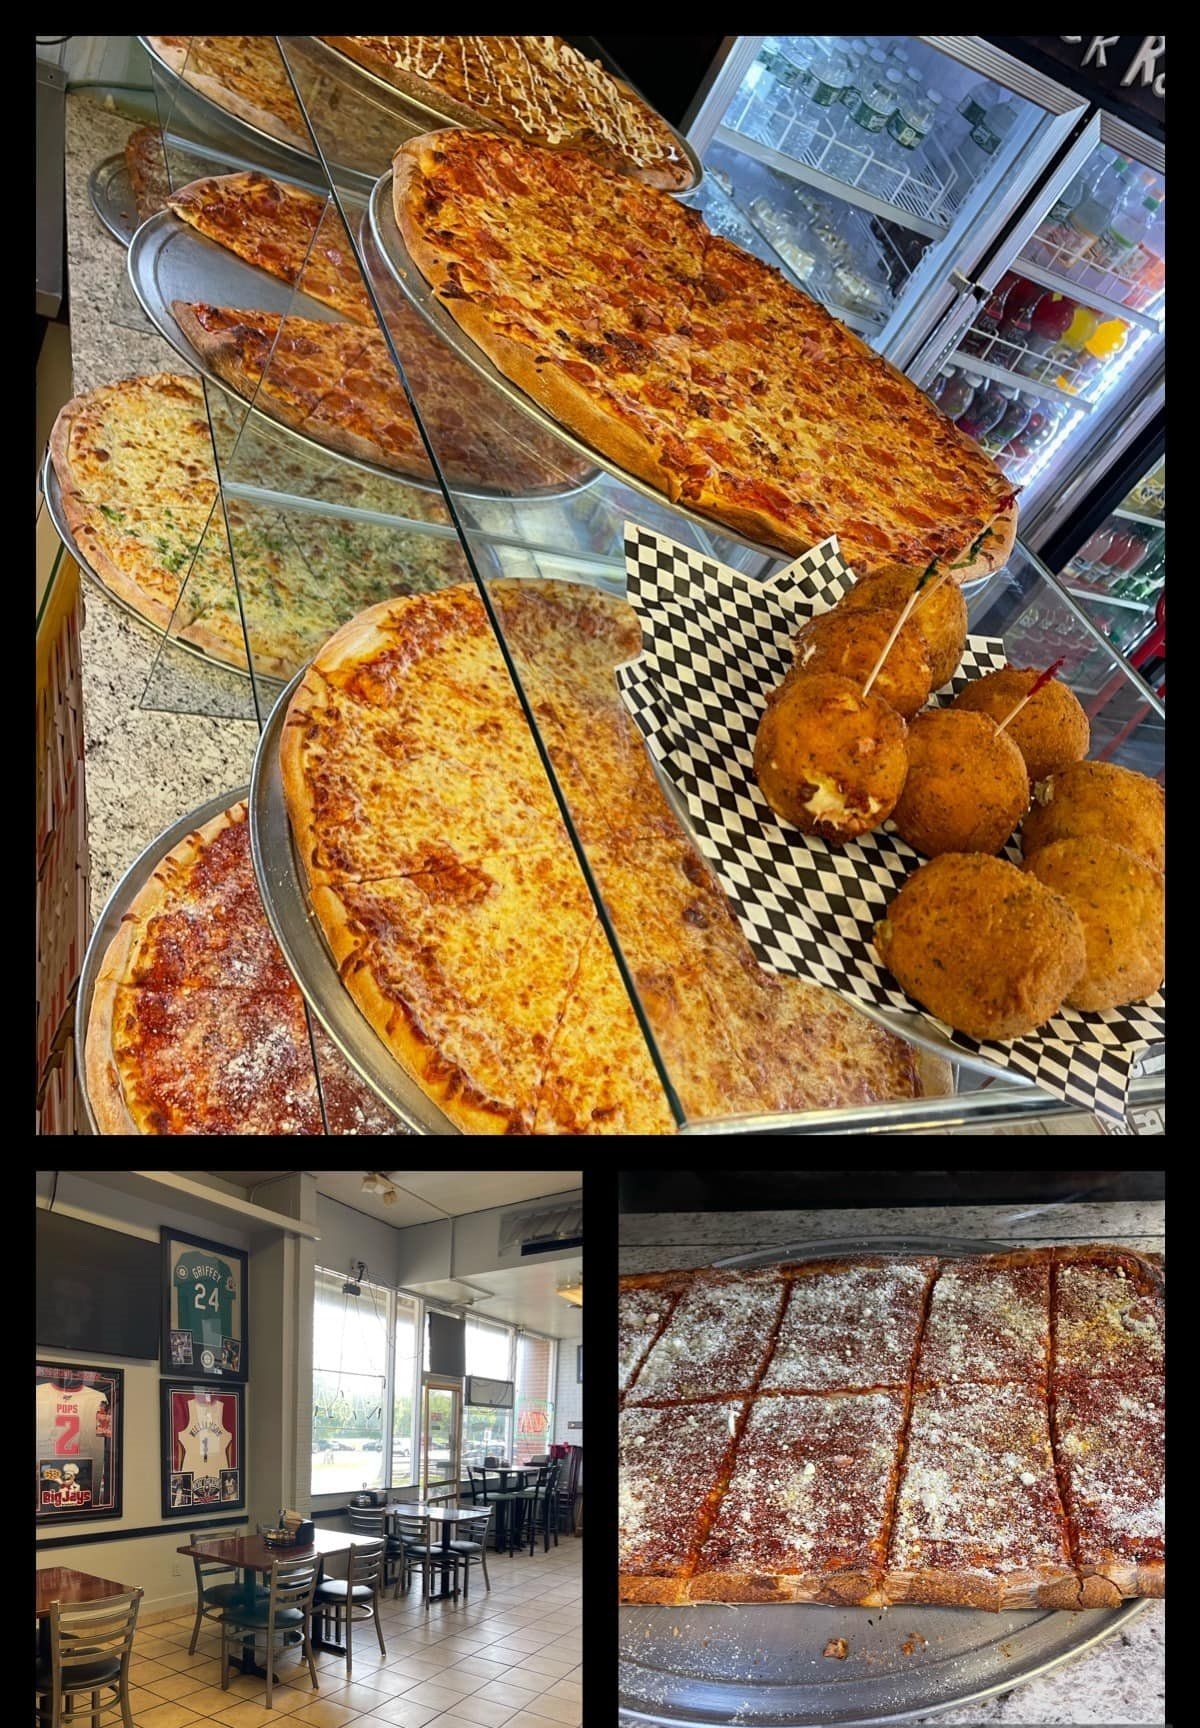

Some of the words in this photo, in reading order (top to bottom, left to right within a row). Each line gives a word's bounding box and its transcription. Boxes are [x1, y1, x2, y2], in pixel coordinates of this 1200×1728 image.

[1060, 35, 1120, 67] K
[192, 1264, 221, 1282] GRIFFEY
[194, 1283, 220, 1312] 24
[56, 1403, 79, 1414] POPS
[55, 1415, 80, 1456] 2
[202, 1437, 209, 1463] 1
[42, 1490, 62, 1507] Big
